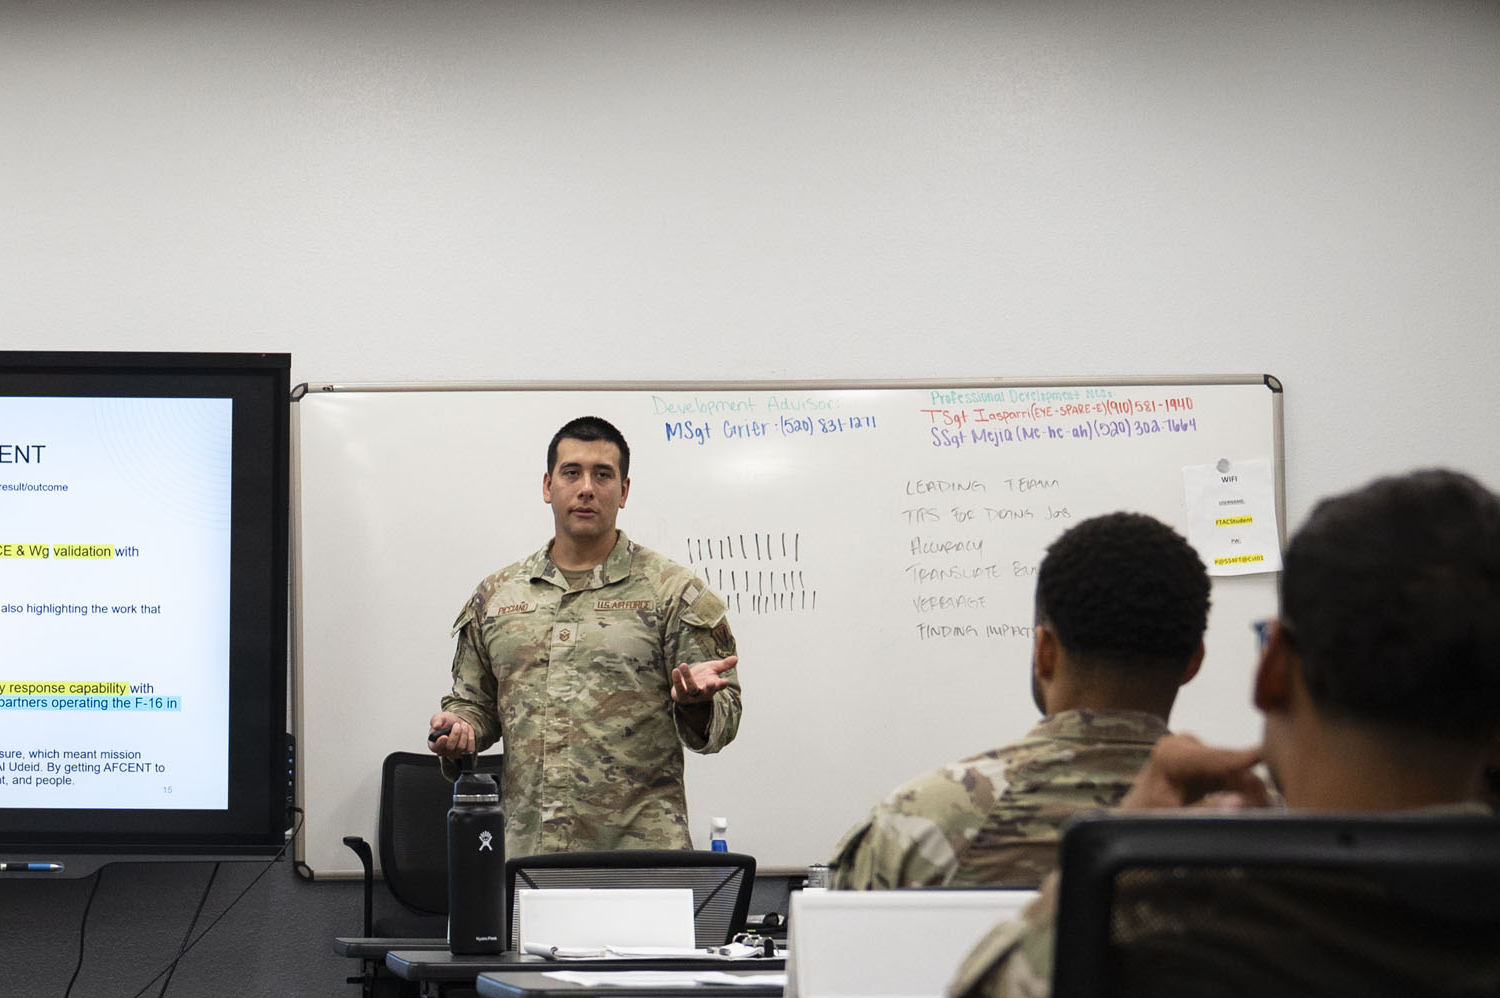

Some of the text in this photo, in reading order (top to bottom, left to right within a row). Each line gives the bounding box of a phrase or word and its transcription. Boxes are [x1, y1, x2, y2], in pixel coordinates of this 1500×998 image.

[652, 395, 756, 416] Development
[920, 409, 969, 429] TSgt
[1106, 399, 1134, 416] (910)
[1135, 397, 1194, 413] 581-1940
[665, 420, 711, 445] MSgt
[931, 426, 967, 448] SSgt
[1094, 418, 1131, 437] (520)
[1220, 475, 1238, 483] WIFI
[29, 545, 49, 559] Wg
[53, 545, 111, 556] validation
[115, 545, 139, 556] with
[1, 603, 23, 613] also
[27, 603, 88, 616] highlighting
[111, 604, 137, 613] work
[141, 604, 160, 613] that
[612, 600, 626, 609] AIR
[626, 600, 650, 609] FORCE
[10, 684, 65, 696] response
[69, 683, 126, 697] capability
[130, 683, 154, 694] with
[52, 697, 108, 711] operating
[135, 697, 163, 708] F-16
[29, 749, 59, 758] which
[63, 749, 97, 759] meant
[100, 749, 141, 759] mission
[9, 762, 43, 771] Udeid.
[47, 762, 61, 774] By
[64, 762, 100, 774] getting
[103, 762, 151, 772] AFCENT
[12, 775, 32, 784] and
[36, 775, 74, 787] people.
